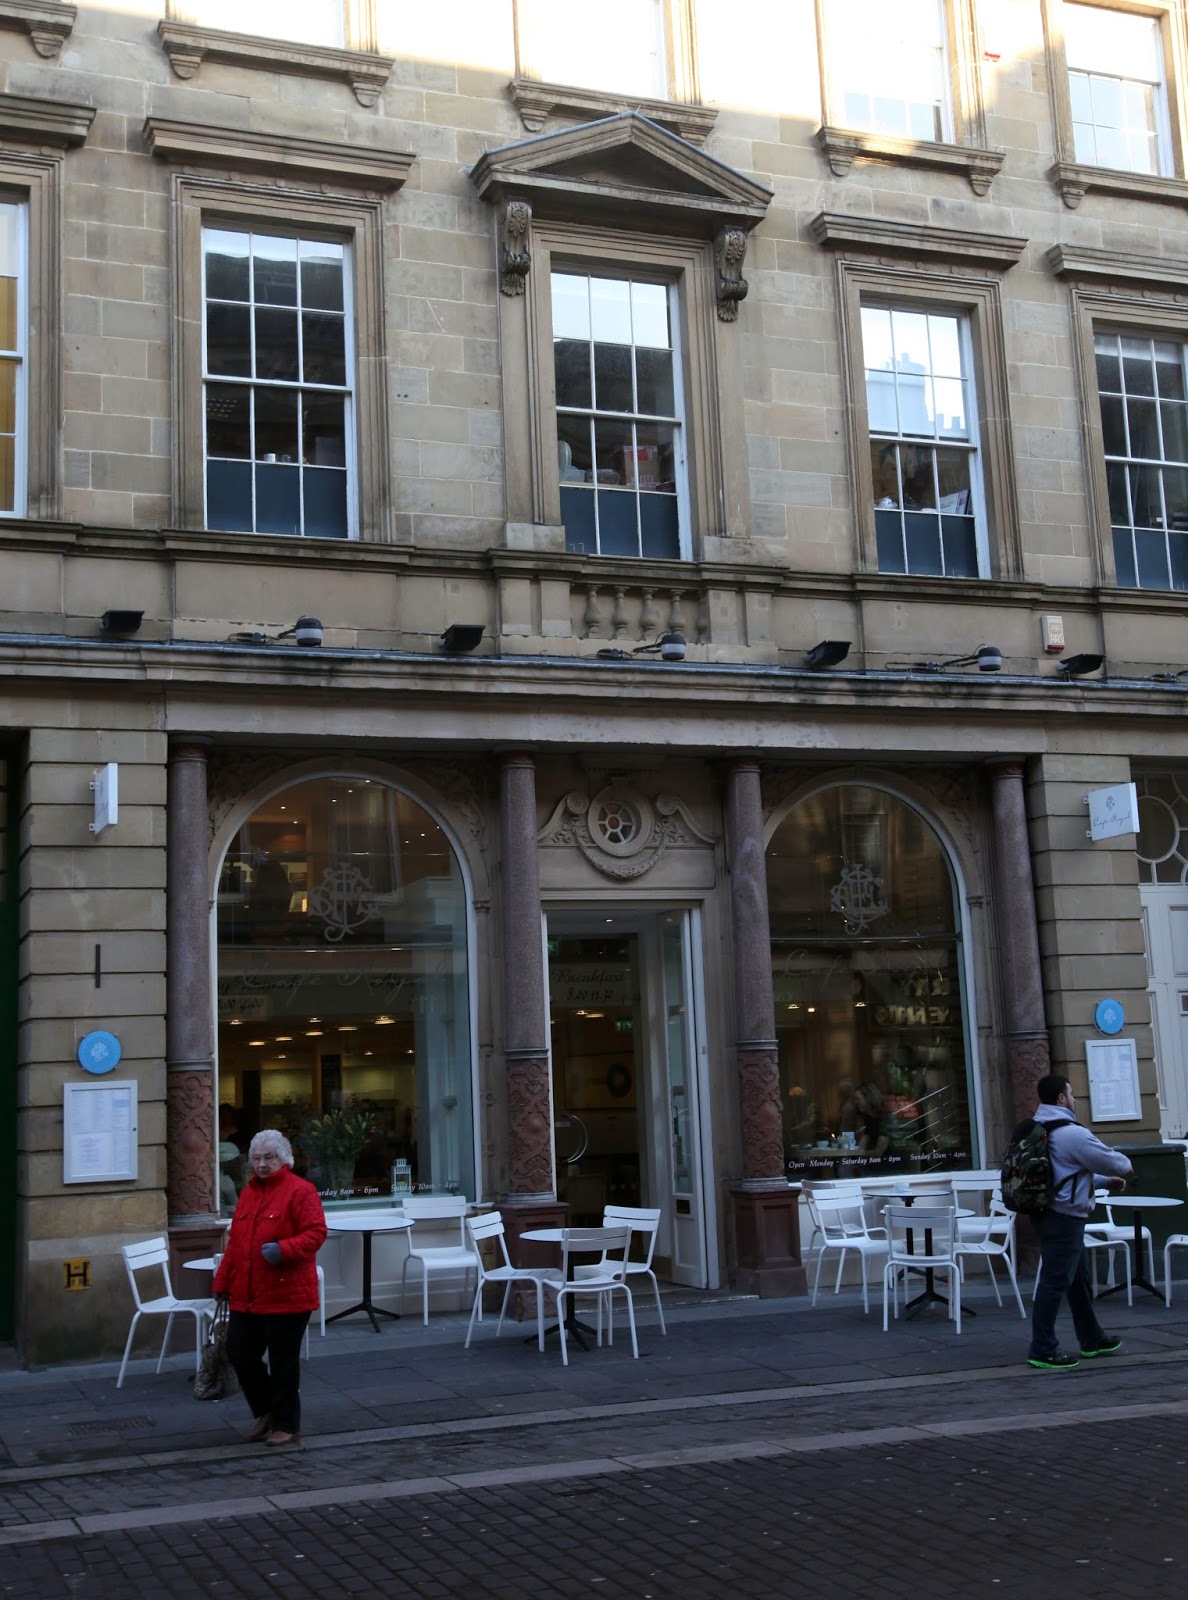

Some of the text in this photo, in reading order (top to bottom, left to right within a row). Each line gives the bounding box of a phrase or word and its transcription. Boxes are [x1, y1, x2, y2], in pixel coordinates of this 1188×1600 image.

[788, 1161, 805, 1170] Open
[809, 1159, 834, 1168] Monday
[841, 1157, 868, 1167] Saturday
[869, 1156, 882, 1164] 8am
[888, 1155, 902, 1164] 6pm
[910, 1153, 932, 1162] Sunday
[339, 1187, 355, 1196] 8am
[363, 1186, 379, 1195] 6pm
[67, 1261, 87, 1288] H
